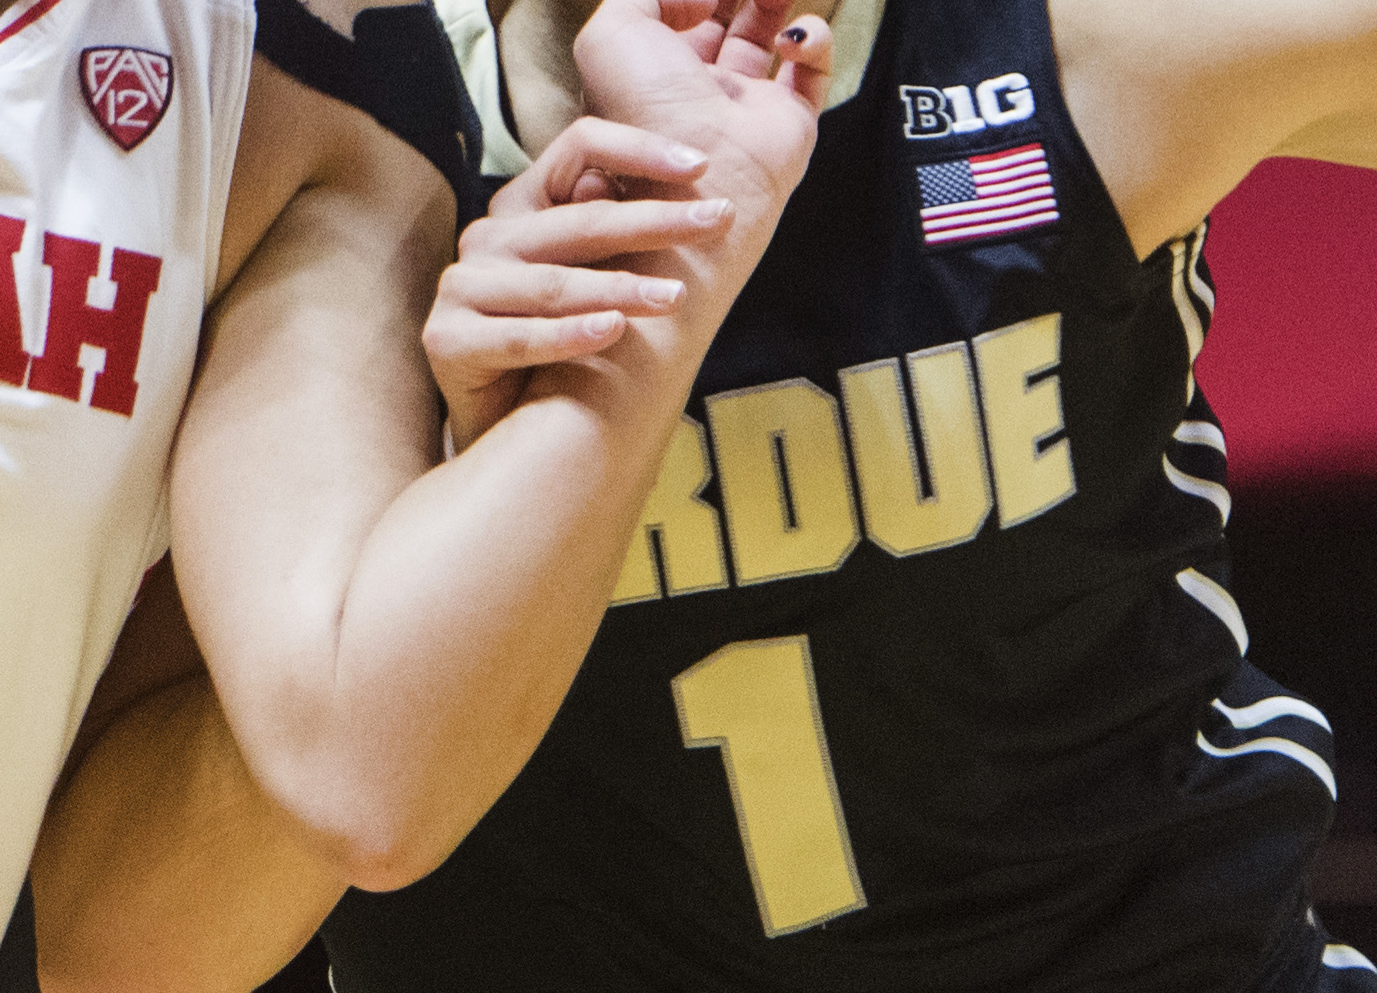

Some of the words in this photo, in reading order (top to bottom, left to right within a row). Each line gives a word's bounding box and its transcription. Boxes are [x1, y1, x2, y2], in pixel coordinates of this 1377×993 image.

[86, 49, 169, 109] PAC
[107, 88, 149, 127] 12
[671, 633, 868, 939] 1
